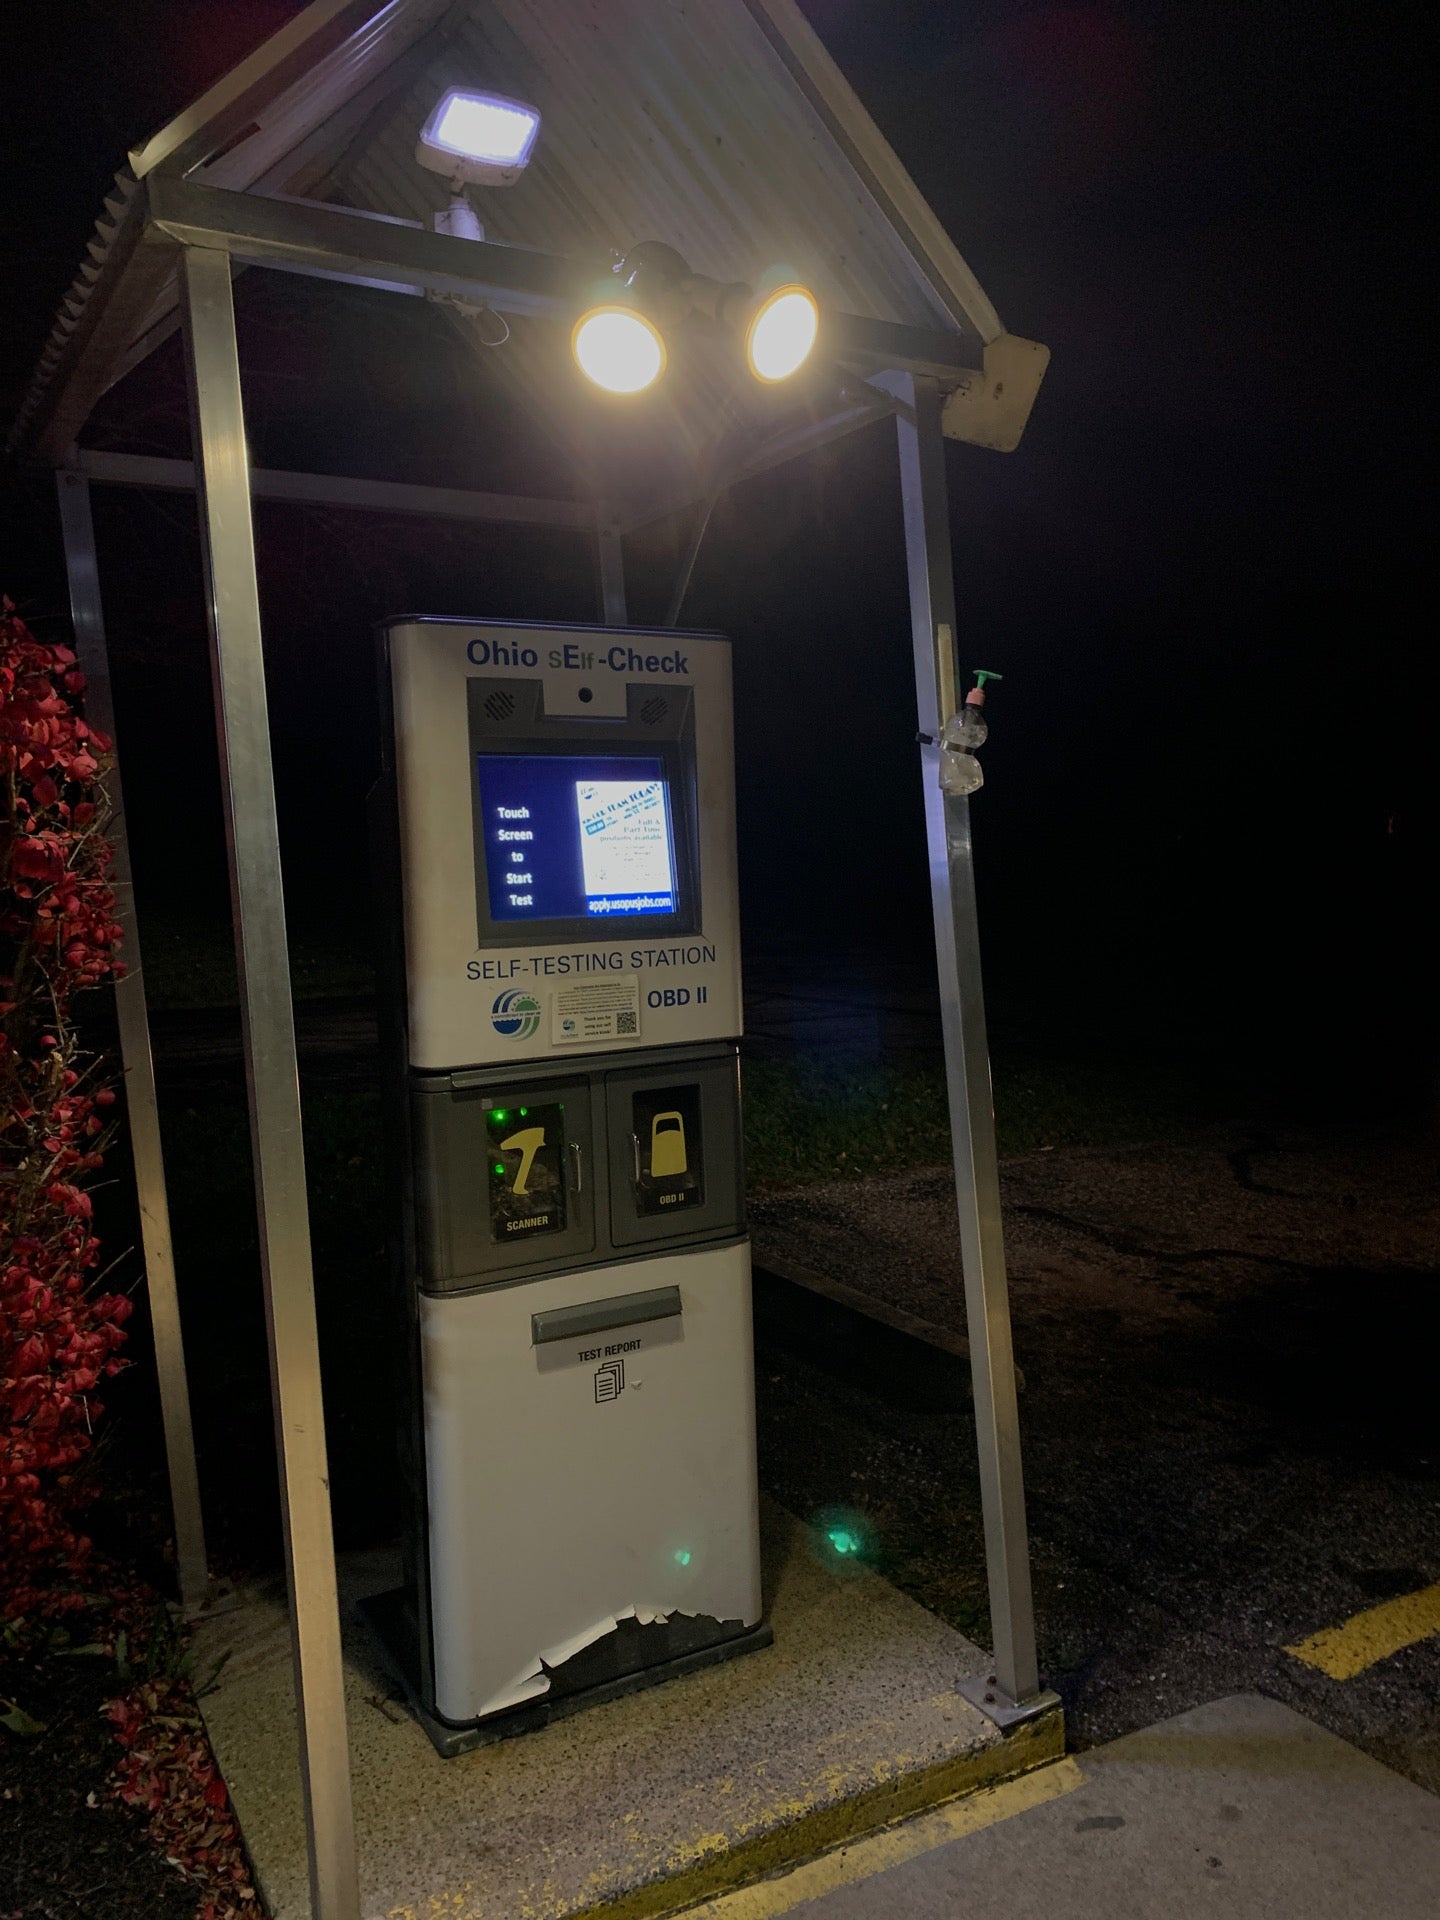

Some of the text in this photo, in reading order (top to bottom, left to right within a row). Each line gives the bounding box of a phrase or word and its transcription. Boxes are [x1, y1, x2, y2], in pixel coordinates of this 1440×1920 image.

[466, 639, 538, 668] Ohio
[498, 806, 530, 819] Touch
[498, 829, 533, 841] Screen
[511, 851, 524, 863] to
[506, 872, 533, 885] Start
[509, 893, 533, 907] Test
[467, 945, 716, 980] SELF-TESTING STATION
[647, 987, 691, 1009] OBD
[696, 986, 707, 1004] II
[660, 1195, 677, 1205] OBD
[506, 1215, 549, 1231] SCANNER
[578, 1339, 642, 1362] TEST REPORT
